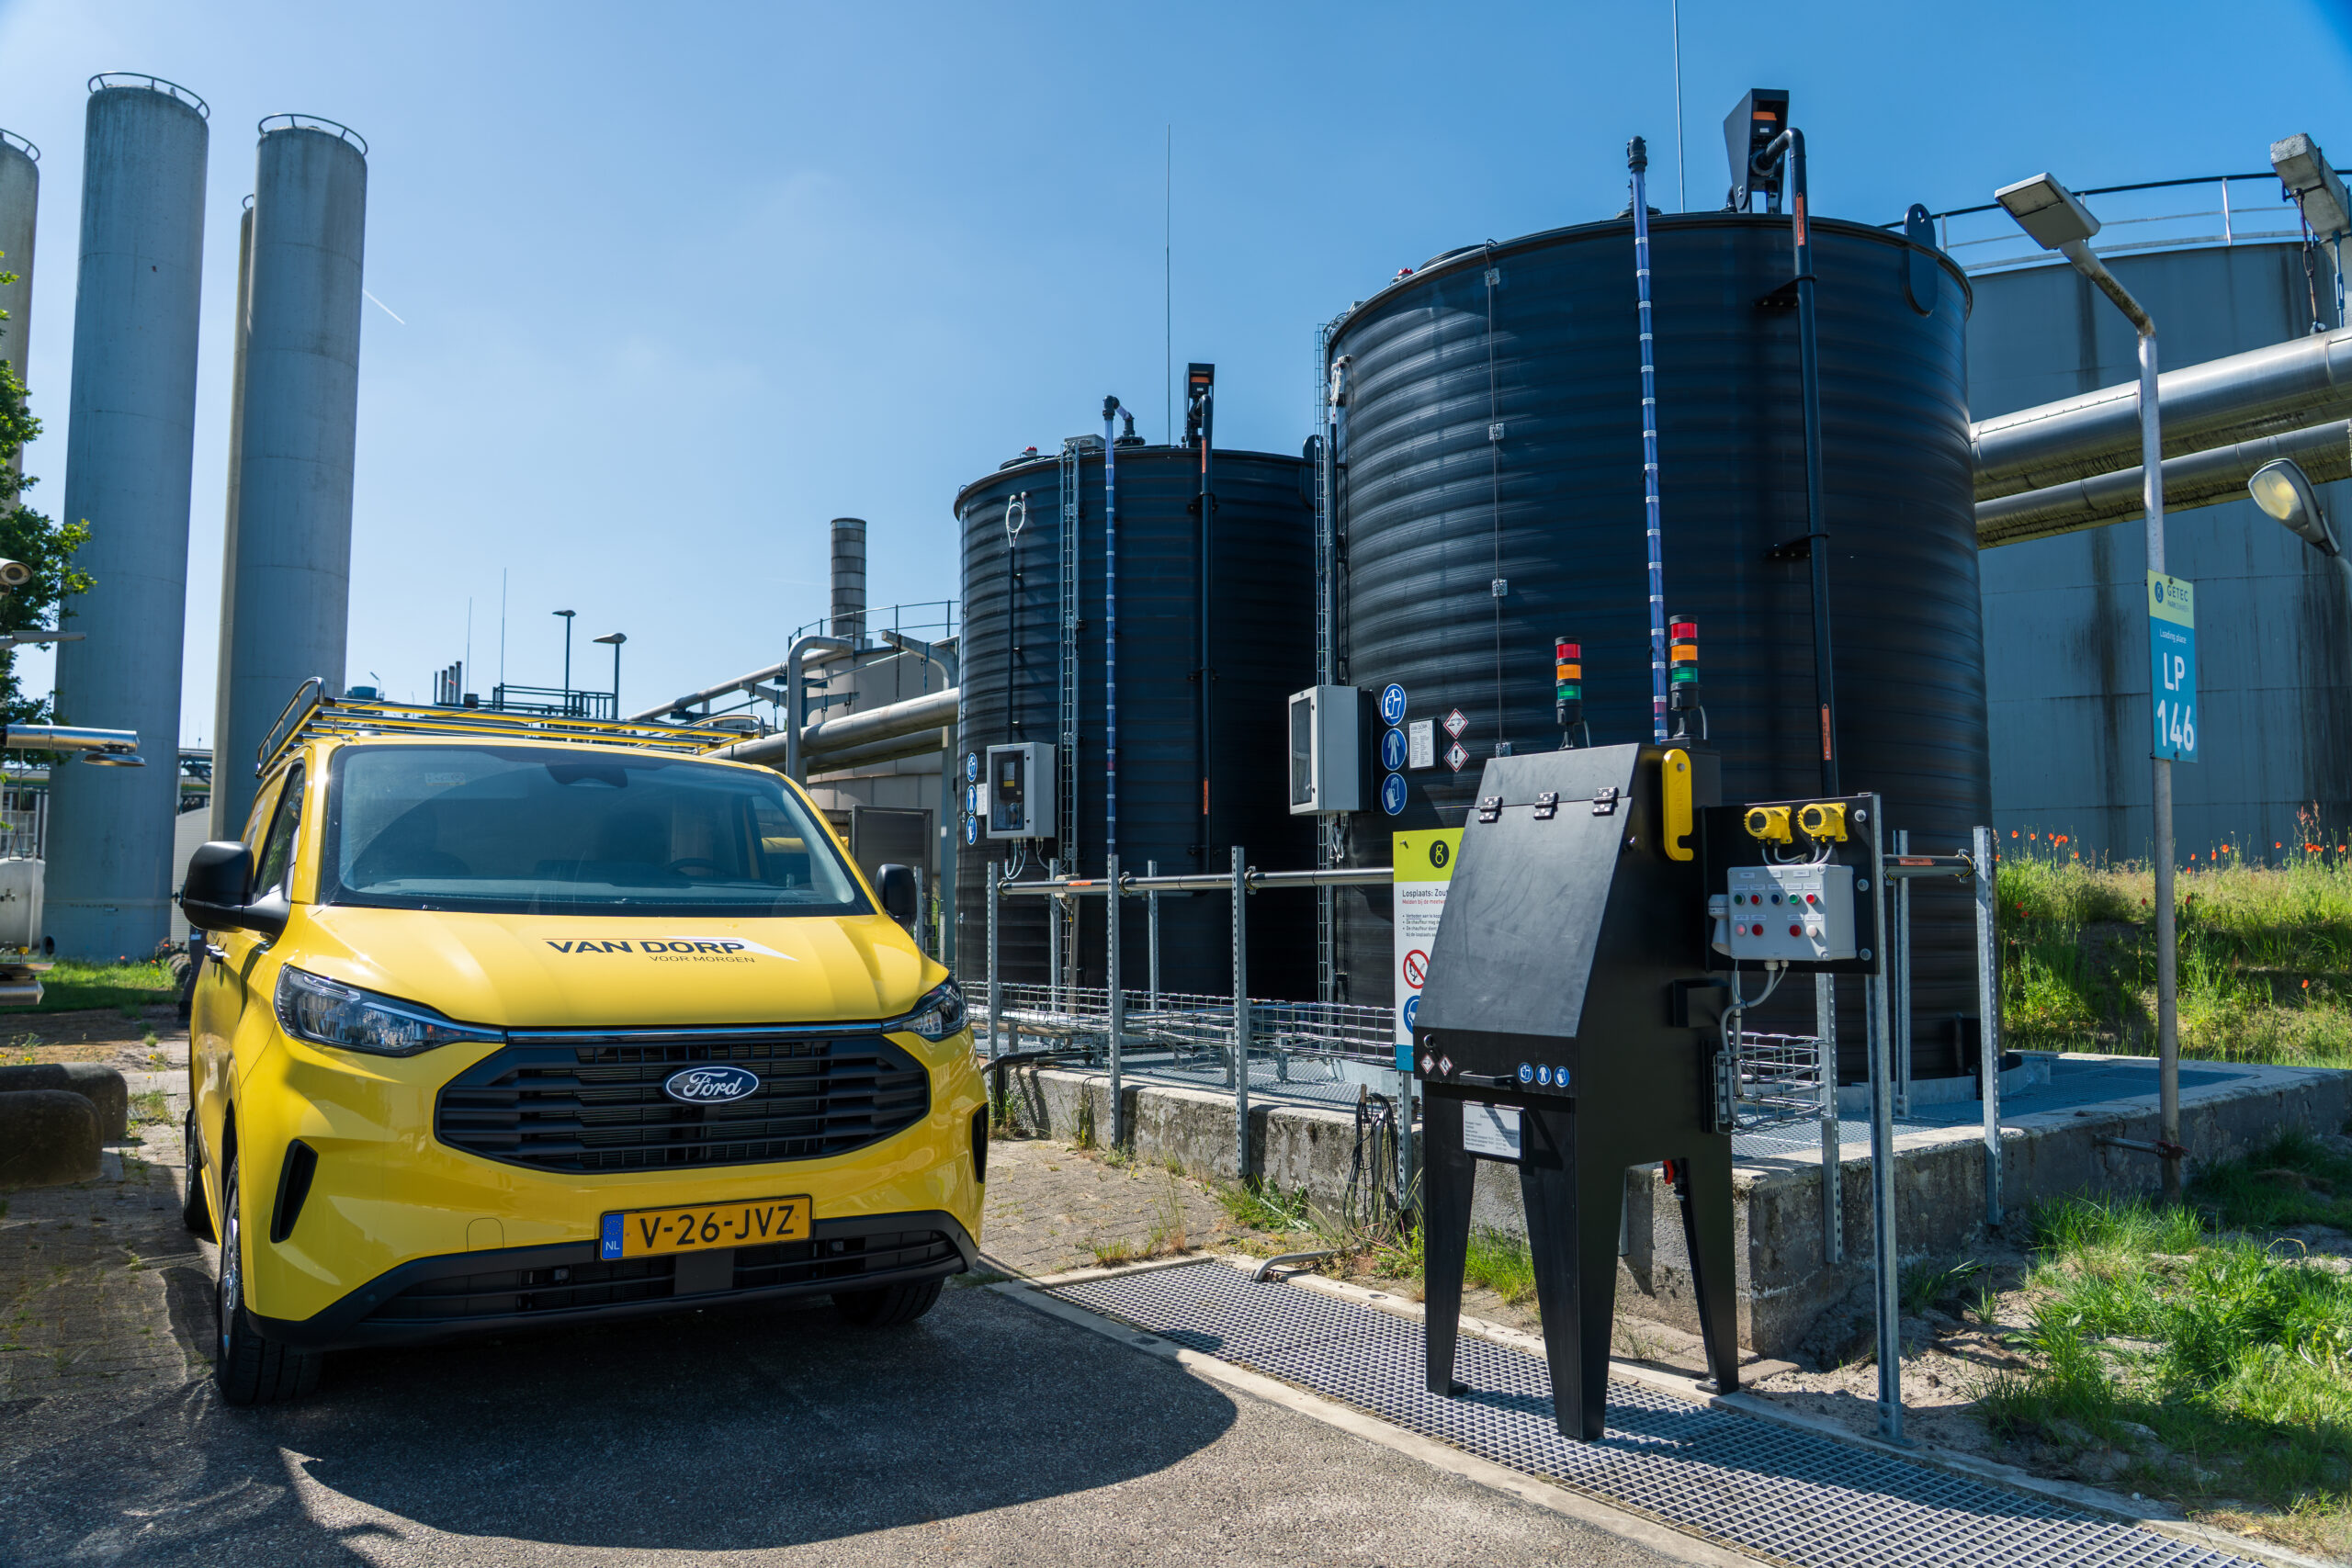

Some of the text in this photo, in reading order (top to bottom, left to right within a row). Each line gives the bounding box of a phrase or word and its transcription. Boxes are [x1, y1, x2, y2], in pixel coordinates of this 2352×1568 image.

[2166, 584, 2188, 603] GETEC
[2159, 627, 2176, 643] Loading
[2163, 651, 2186, 692] LP
[2156, 698, 2195, 751] 146
[1402, 889, 1433, 898] Losplaats:
[545, 941, 745, 954] VAN DORP
[683, 1071, 743, 1097] Ford
[639, 1204, 796, 1249] V-26-JVZ
[605, 1240, 621, 1252] NL
